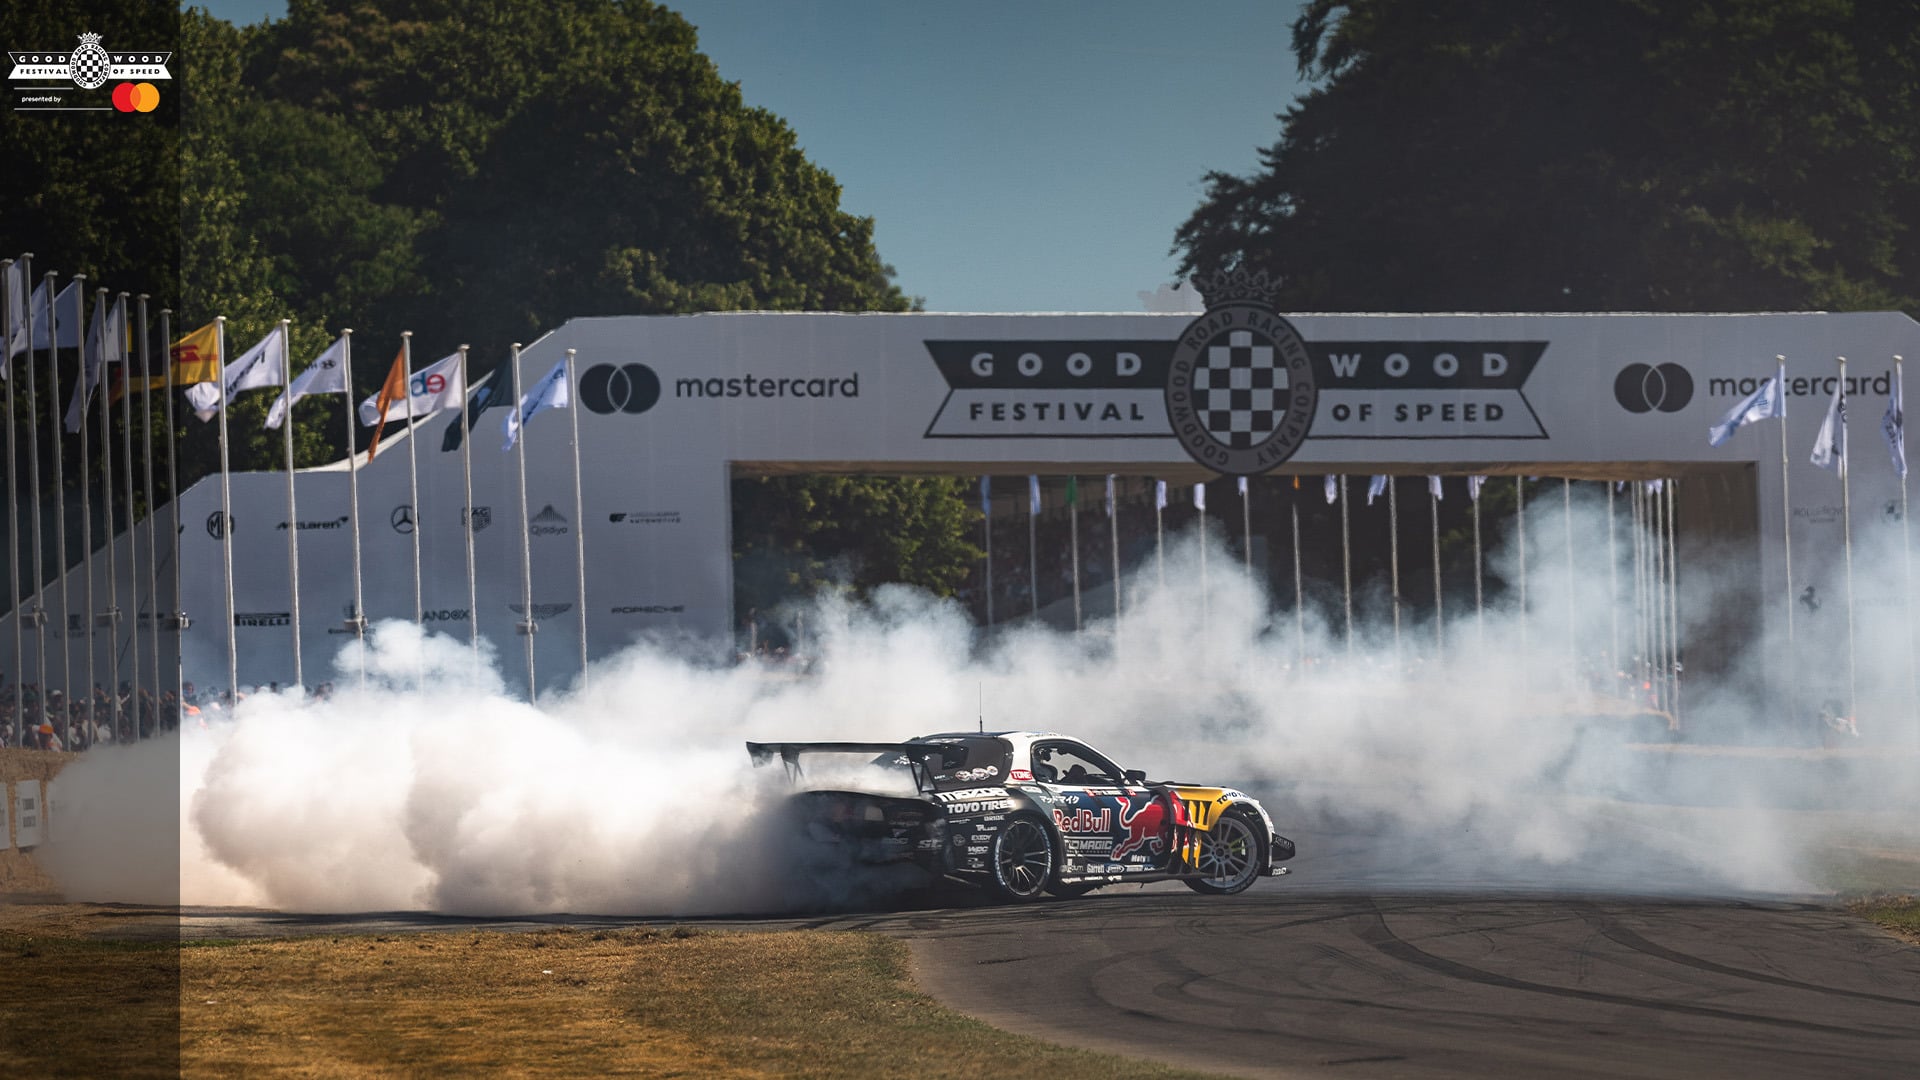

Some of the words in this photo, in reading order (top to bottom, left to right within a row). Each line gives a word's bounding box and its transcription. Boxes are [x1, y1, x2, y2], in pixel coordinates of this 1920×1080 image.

[1187, 311, 1234, 351] ROAD
[1247, 311, 1306, 369] RACING
[970, 352, 1142, 377] GOOD
[1328, 353, 1509, 378] WOOD
[675, 372, 859, 398] mastercard
[1709, 370, 1891, 397] maercrd
[969, 402, 1144, 421] FESTIVAL
[1331, 403, 1373, 422] OF
[1394, 403, 1504, 422] SPEED
[1171, 358, 1230, 466] GOODWOOD
[1256, 380, 1306, 466] COMPANY
[234, 612, 291, 628] PIRELLI
[421, 608, 470, 621] ANDOX
[611, 604, 685, 614] PORSCHE
[946, 802, 980, 814] TOYO
[980, 799, 1017, 811] TIRES
[1039, 796, 1080, 804] マッドマイク
[1216, 791, 1238, 805] TOYO
[1052, 808, 1081, 833] Red
[1082, 808, 1111, 833] Bull
[1087, 863, 1105, 873] Garrett
